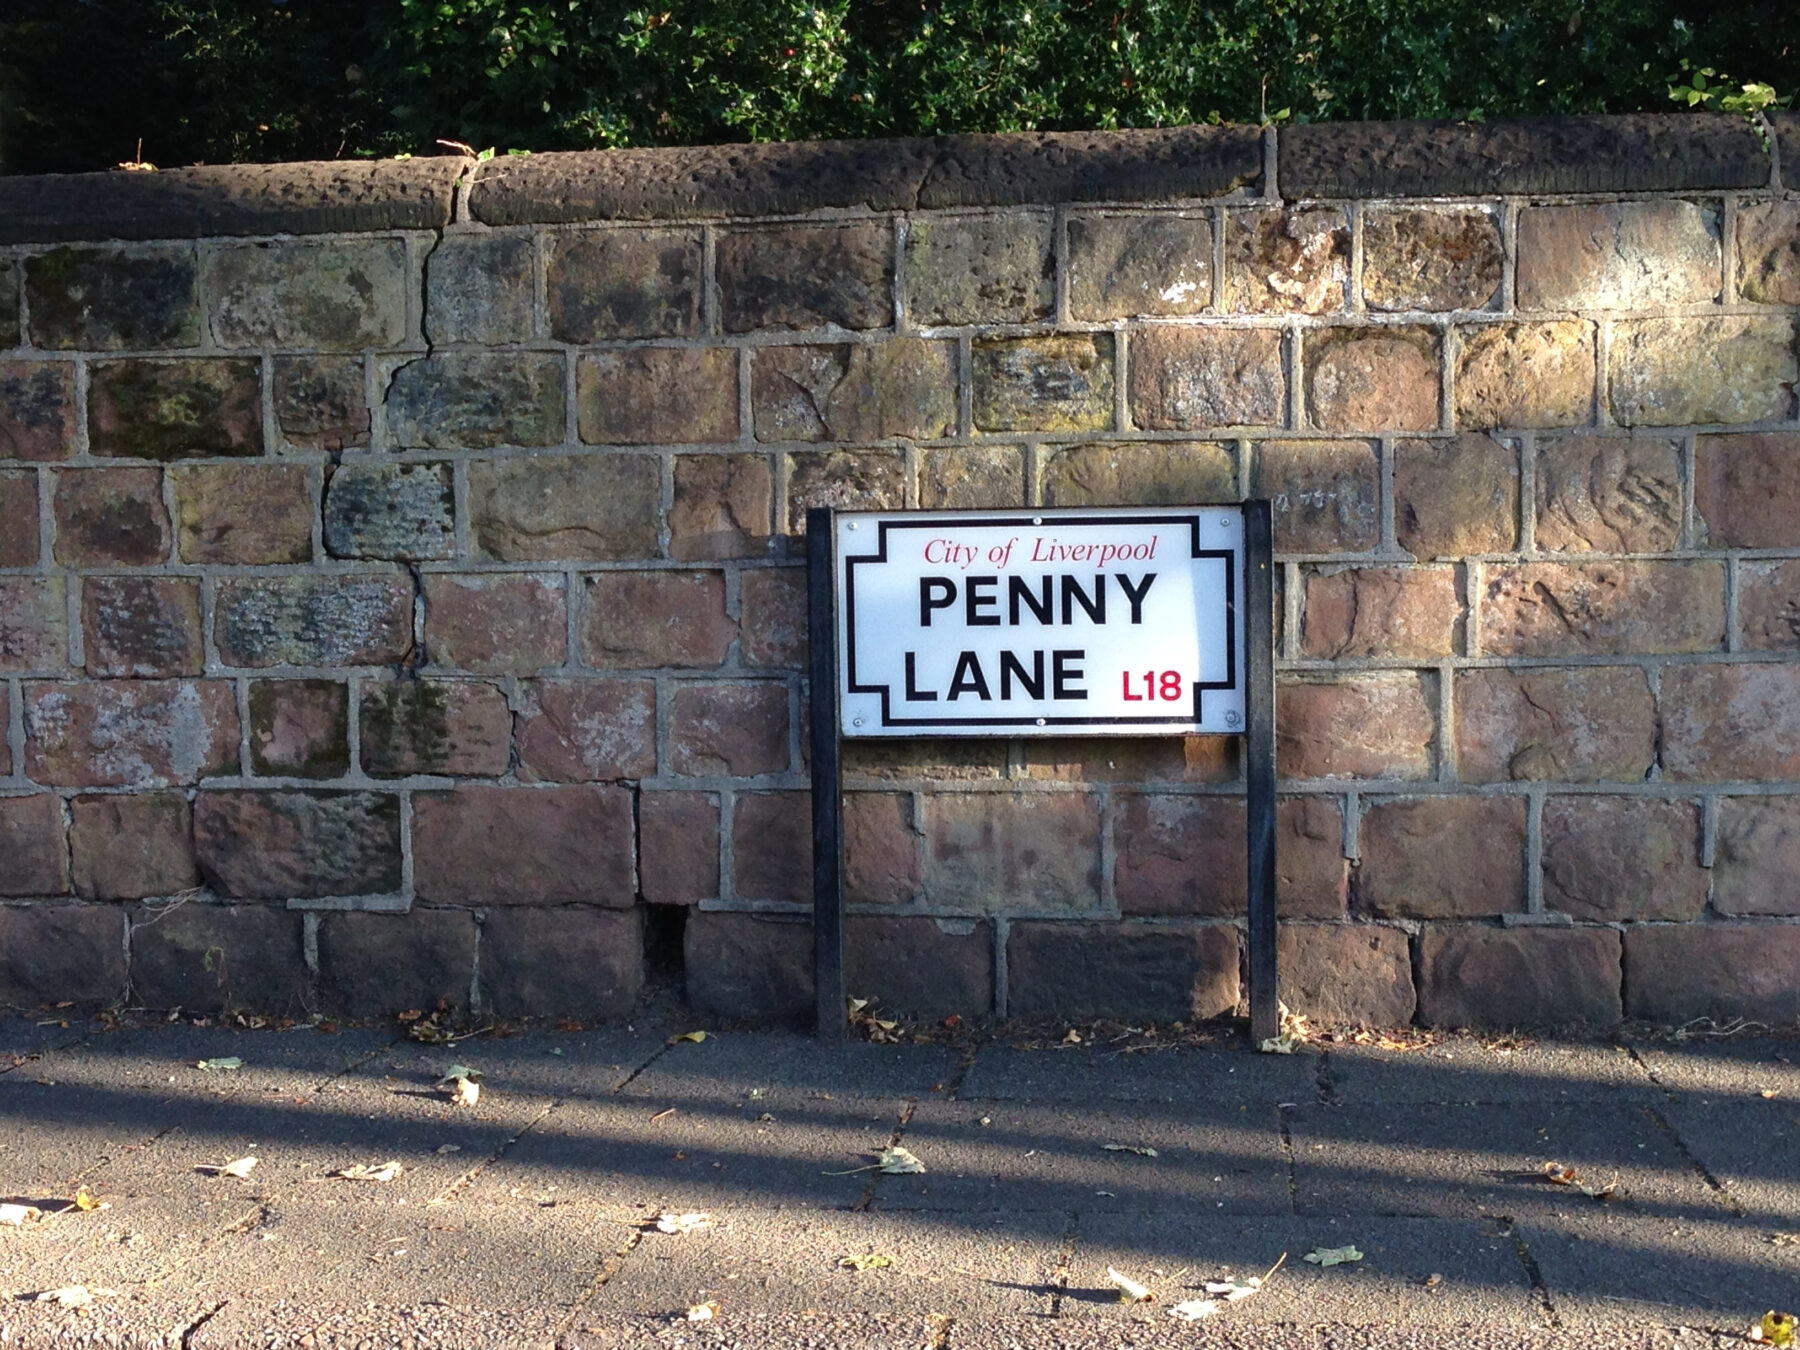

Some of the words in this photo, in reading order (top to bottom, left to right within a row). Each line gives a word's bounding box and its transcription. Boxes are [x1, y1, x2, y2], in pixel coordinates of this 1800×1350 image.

[924, 538, 978, 570] City
[987, 537, 1019, 569] of
[1030, 535, 1158, 568] Liverpool
[919, 573, 1158, 627] PENNY
[904, 650, 1088, 702] LANE
[1122, 670, 1182, 701] L18
